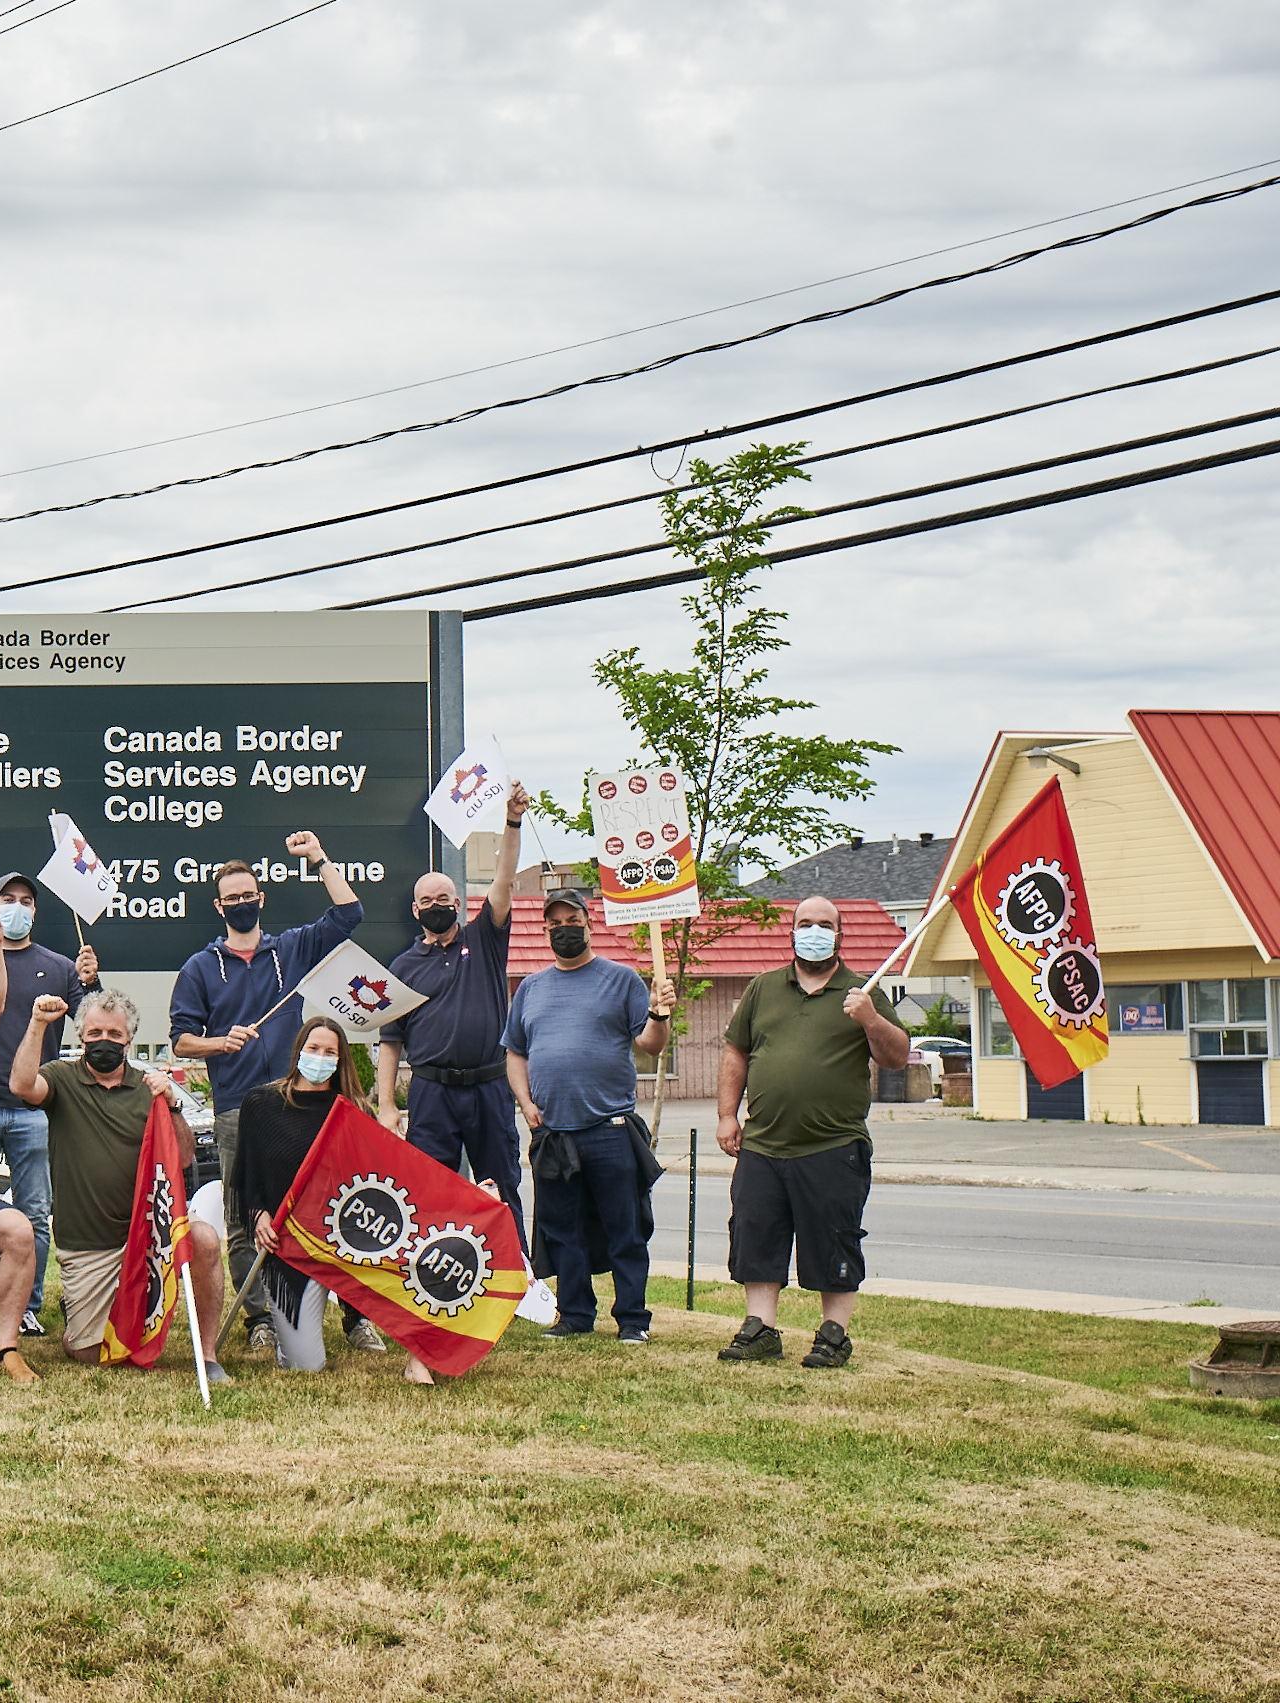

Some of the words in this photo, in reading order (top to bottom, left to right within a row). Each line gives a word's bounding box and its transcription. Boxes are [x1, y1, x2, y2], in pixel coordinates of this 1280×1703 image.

[41, 630, 110, 646] Border
[50, 653, 126, 673] Agency
[104, 727, 222, 753] Canada
[237, 725, 342, 751] Border
[104, 761, 237, 787] Services
[250, 760, 367, 792] Agency
[104, 796, 223, 827] College
[466, 783, 504, 818] CIU-SDI
[600, 797, 680, 832] RESPECT
[108, 860, 159, 883] 475
[622, 868, 643, 880] AFPC
[655, 864, 675, 876] PSAC
[106, 892, 186, 918] Road
[1014, 879, 1056, 931] AFPC
[1056, 955, 1089, 1011] PSAC
[329, 996, 369, 1027] CIU-SDI
[343, 1198, 399, 1245] PSAC
[421, 1247, 474, 1293] AFPC
